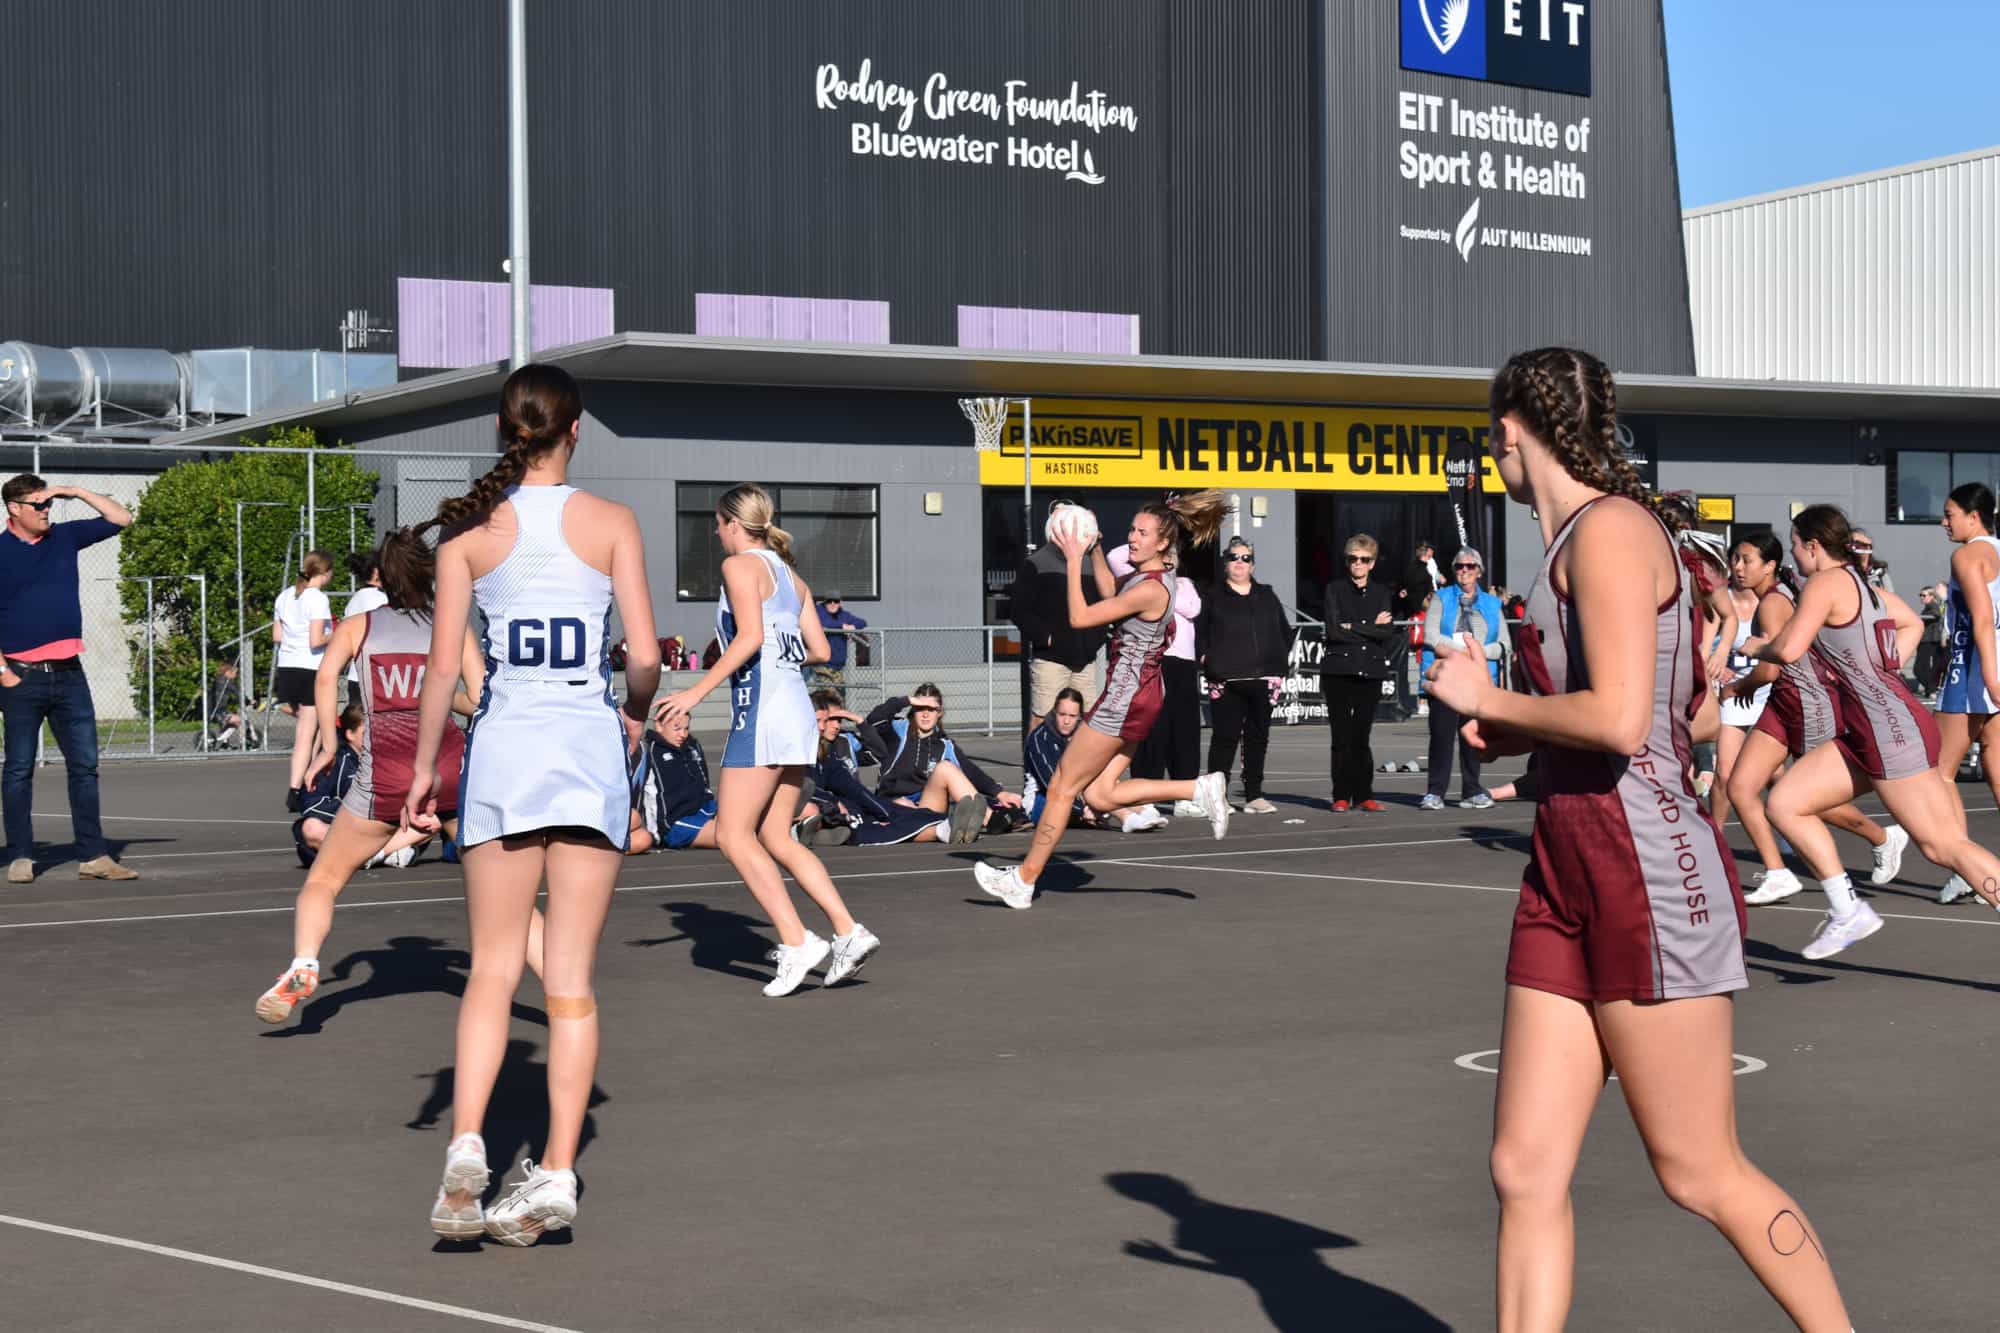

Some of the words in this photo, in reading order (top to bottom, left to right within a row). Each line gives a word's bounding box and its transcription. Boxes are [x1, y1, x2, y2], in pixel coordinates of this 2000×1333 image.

[1504, 0, 1585, 46] EIT
[816, 58, 918, 132] Rodney
[924, 72, 1001, 121] Green
[1003, 80, 1138, 134] Foundation
[851, 122, 999, 165] Bluewater
[1007, 136, 1079, 171] Hotel
[1399, 91, 1444, 133] EIT
[1450, 98, 1559, 150] Institute
[1565, 117, 1590, 153] of
[1399, 141, 1471, 189] Sport
[1477, 151, 1497, 189] &
[1504, 154, 1586, 199] Health
[1399, 224, 1440, 241] Supported
[1440, 229, 1451, 244] by
[1480, 227, 1508, 248] AUT
[1510, 230, 1592, 256] MILLENNIUM
[1044, 462, 1100, 475] HASTINGS
[1158, 416, 1334, 473] NETBALL
[508, 617, 586, 669] GD
[1885, 706, 1907, 748] HOUSE
[1670, 832, 1709, 927] HOUSE
